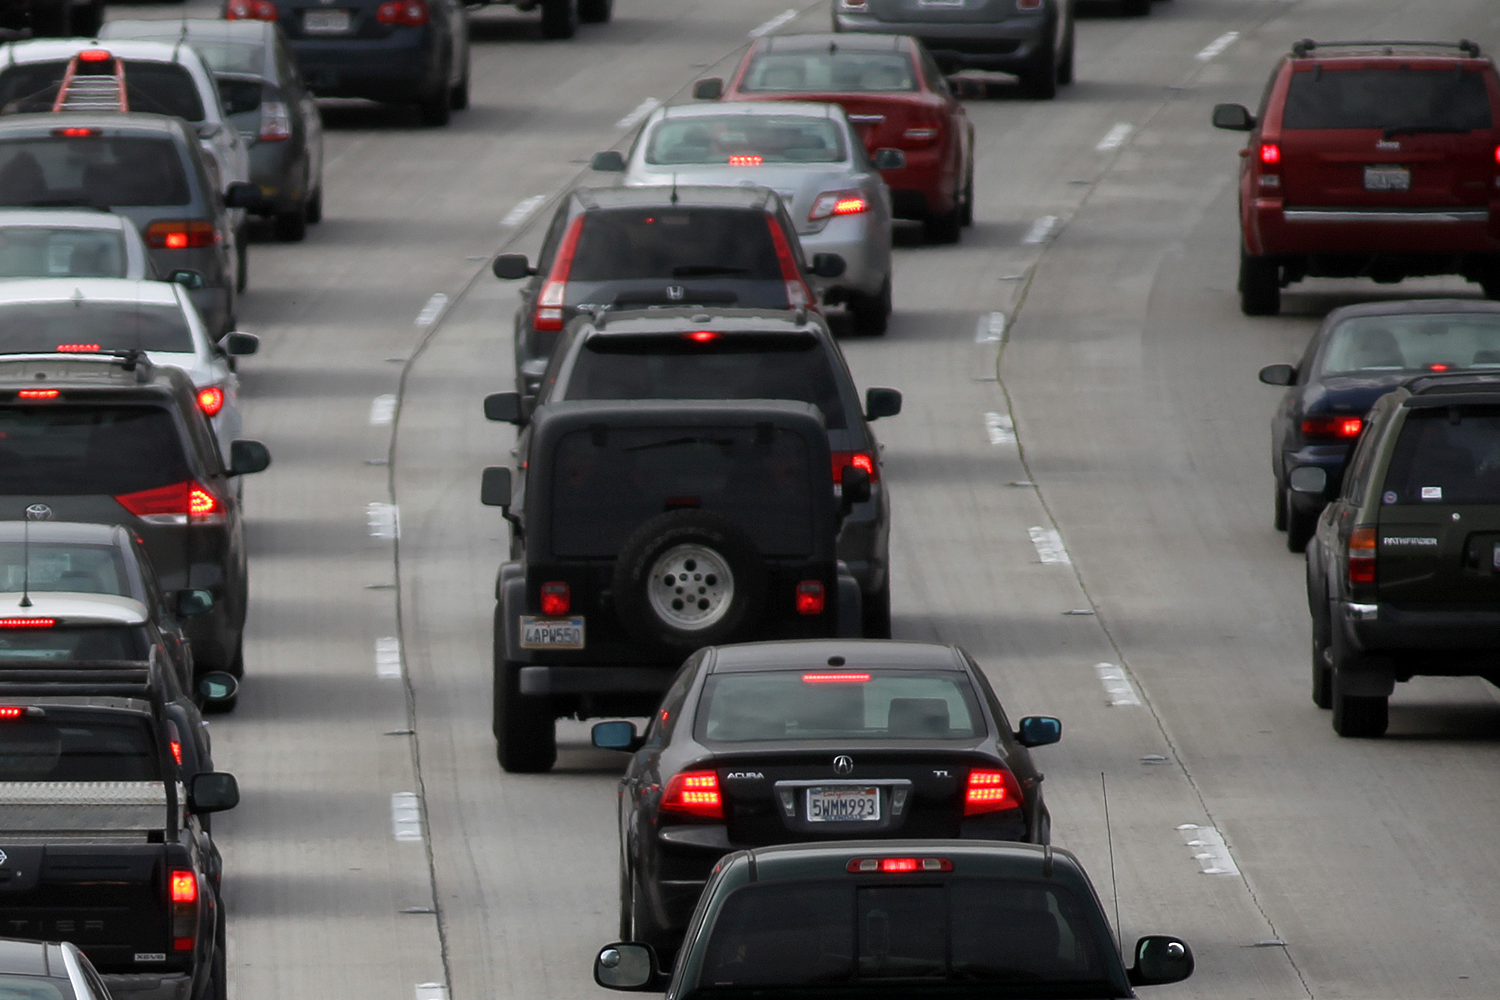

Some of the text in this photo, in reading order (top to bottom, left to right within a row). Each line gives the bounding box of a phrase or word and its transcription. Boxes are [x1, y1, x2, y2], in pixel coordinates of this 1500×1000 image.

[1383, 537, 1438, 545] PATHFINDER
[525, 628, 580, 643] 4APW550
[727, 771, 765, 779] ACURA
[813, 799, 875, 816] 5WMM993
